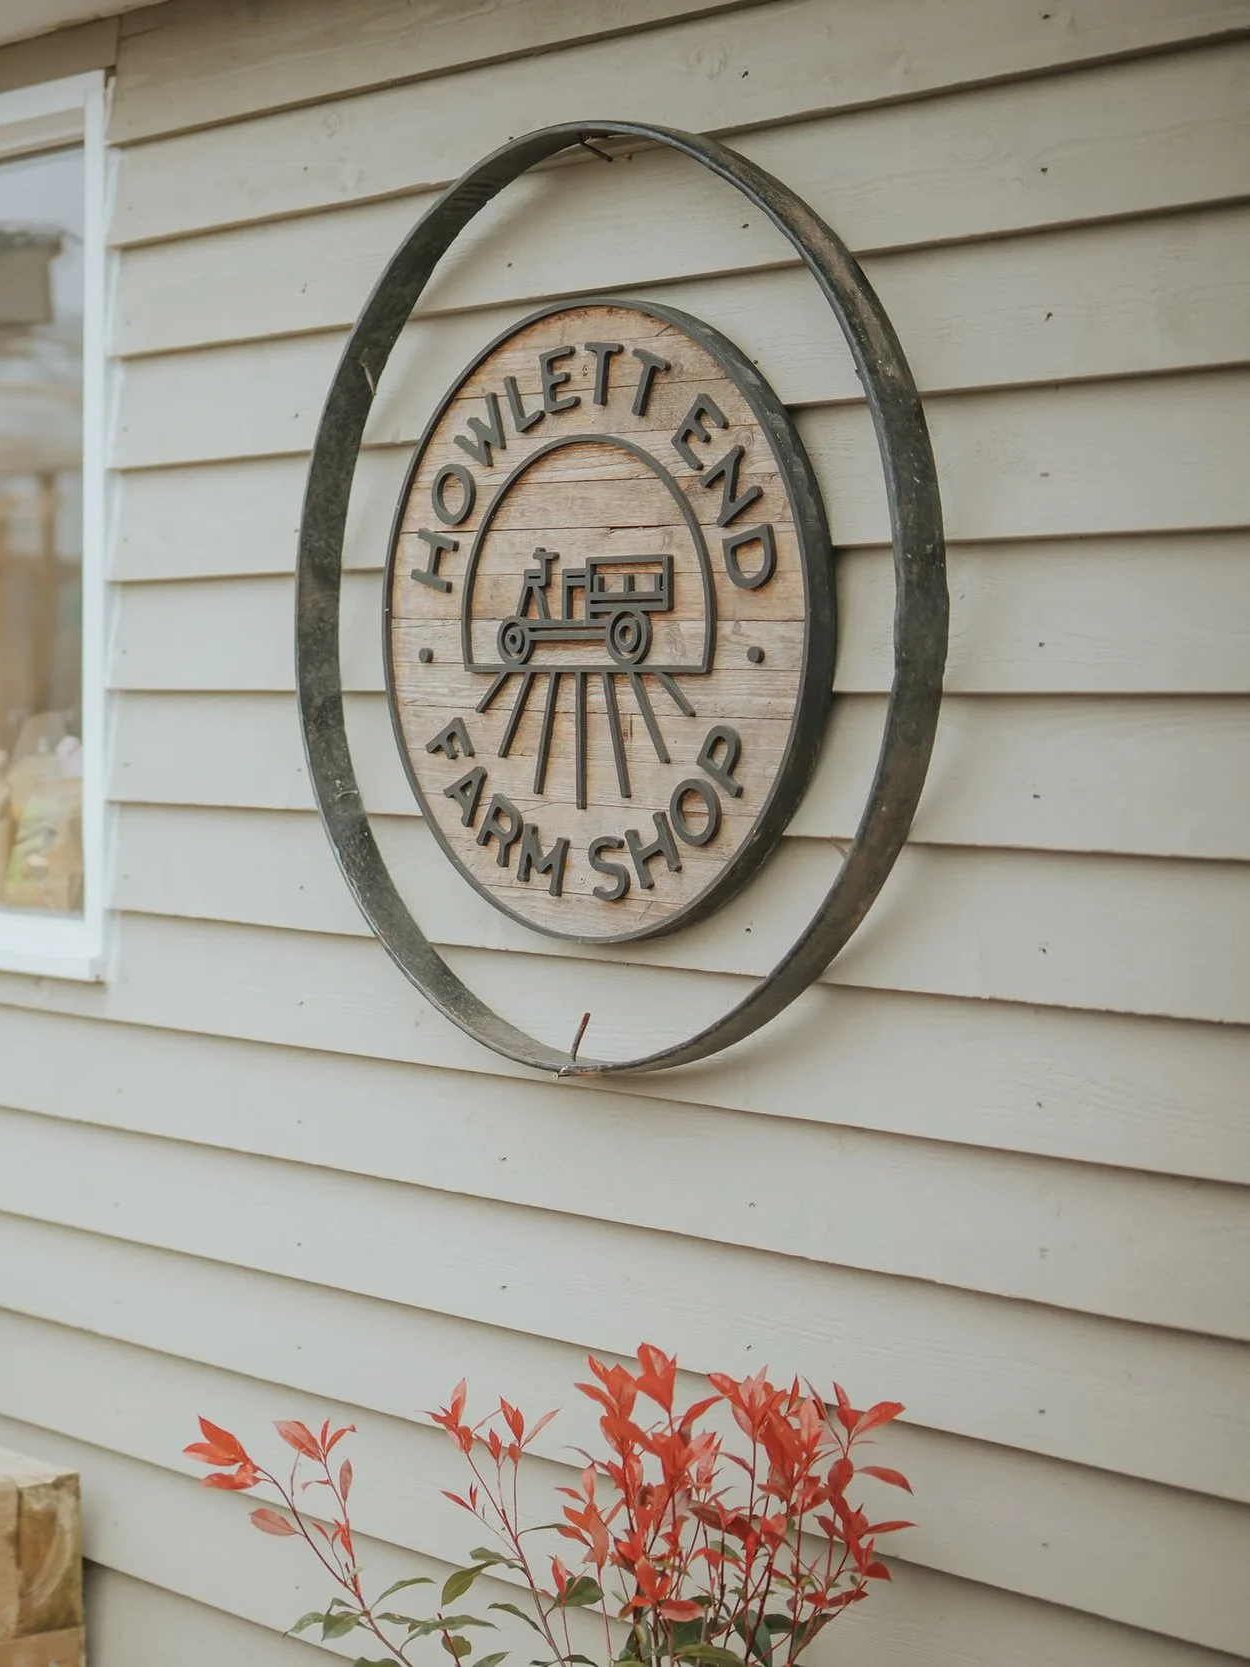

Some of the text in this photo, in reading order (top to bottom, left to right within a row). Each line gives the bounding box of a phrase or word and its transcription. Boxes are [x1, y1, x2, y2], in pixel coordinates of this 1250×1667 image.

[411, 341, 778, 593] HOWLETT END
[426, 716, 744, 901] FARM SHOP
